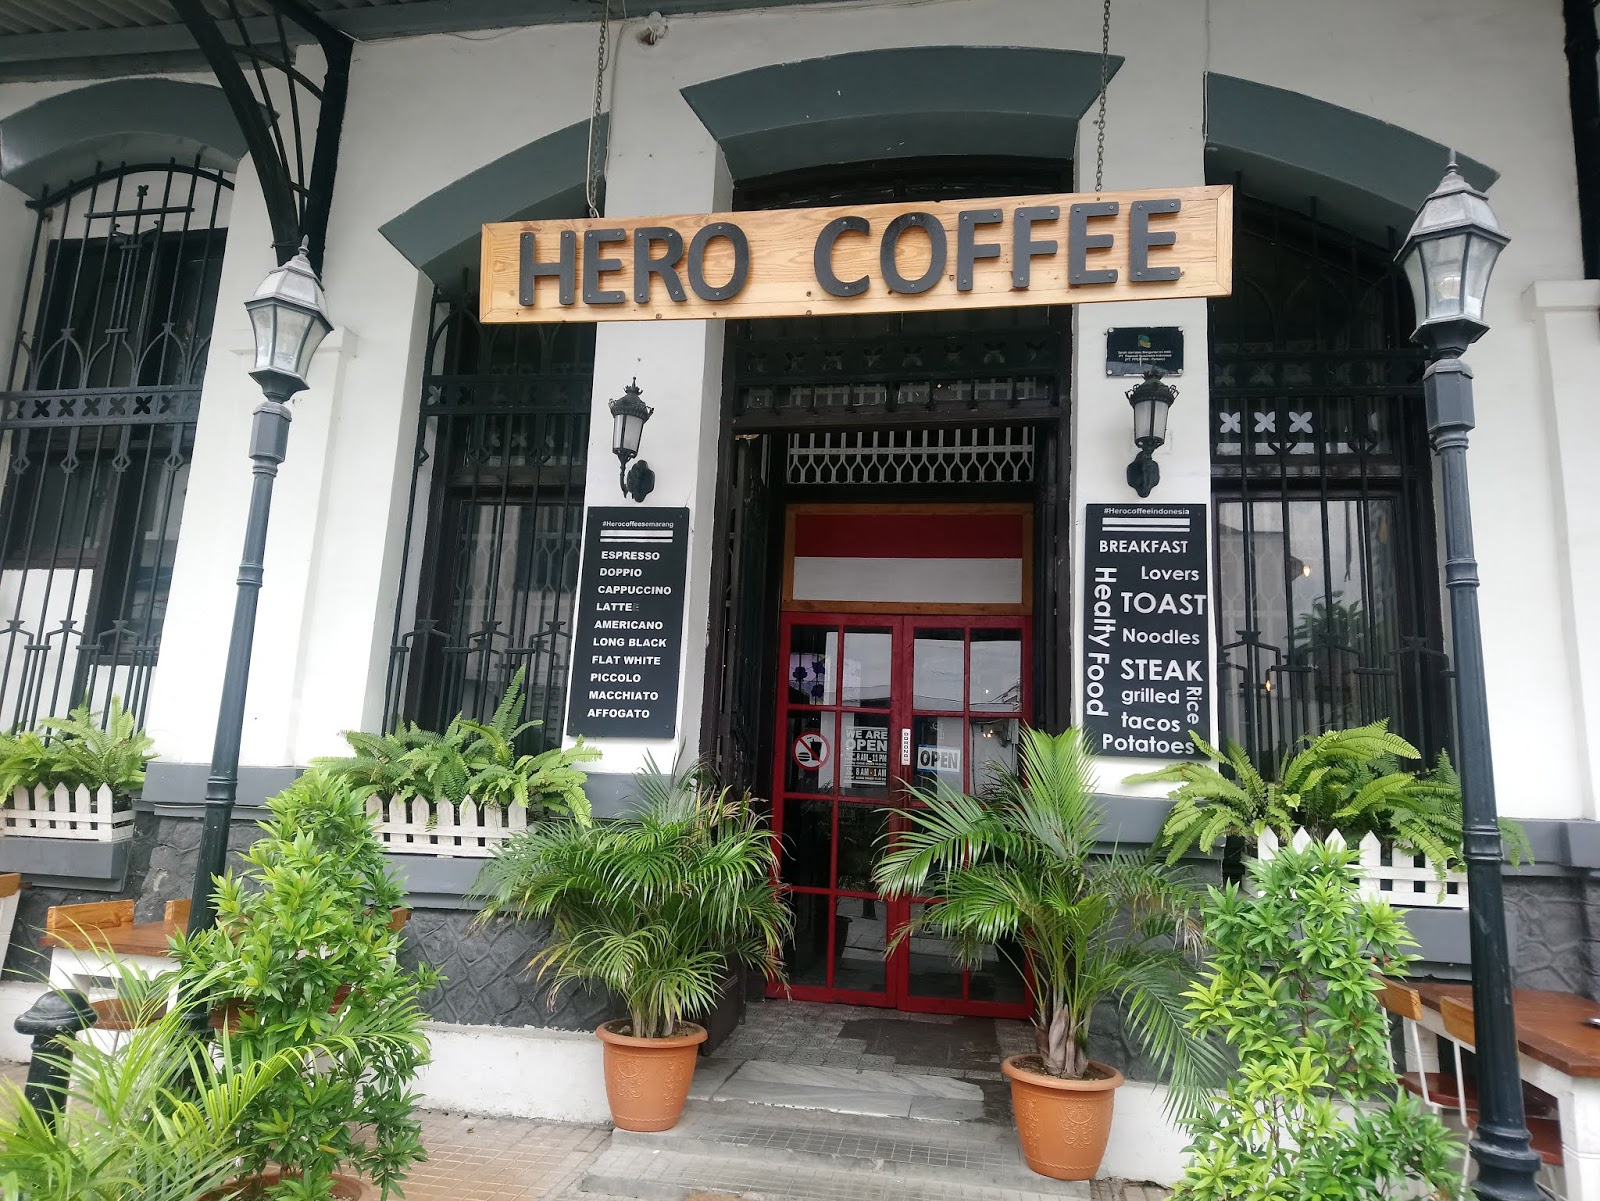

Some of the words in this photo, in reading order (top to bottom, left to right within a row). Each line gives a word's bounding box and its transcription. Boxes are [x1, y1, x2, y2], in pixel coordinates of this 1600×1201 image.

[518, 225, 751, 307] HERO
[814, 198, 1182, 300] COFFEE
[1099, 540, 1188, 553] BREAKFAST
[601, 551, 660, 560] ESPRESSO
[600, 568, 642, 577] DOPPIO
[1141, 565, 1200, 581] Lovers
[598, 586, 672, 595] CAPPUCCINO
[1088, 567, 1118, 647] Healty
[1120, 592, 1207, 615] TOAST
[594, 620, 663, 630] AMERICANO
[593, 638, 625, 647] LONG
[628, 639, 667, 647] BLACK
[1122, 628, 1200, 645] Noodles
[591, 656, 621, 665] FLAT
[623, 656, 661, 665] WHITE
[1120, 658, 1204, 681] STEAK
[590, 673, 641, 683] PICCOLO
[1086, 652, 1110, 716] Food
[589, 691, 659, 701] MACCHIATO
[1121, 687, 1180, 705] grilled
[1186, 686, 1202, 725] Rice
[587, 709, 650, 718] AFFOGATO
[1121, 711, 1180, 732] tacos
[845, 730, 863, 739] WE
[865, 730, 888, 739] ARE
[845, 739, 888, 751] OPEN
[1102, 733, 1195, 754] Potatoes
[879, 755, 887, 763] PM
[920, 750, 959, 769] OPEN
